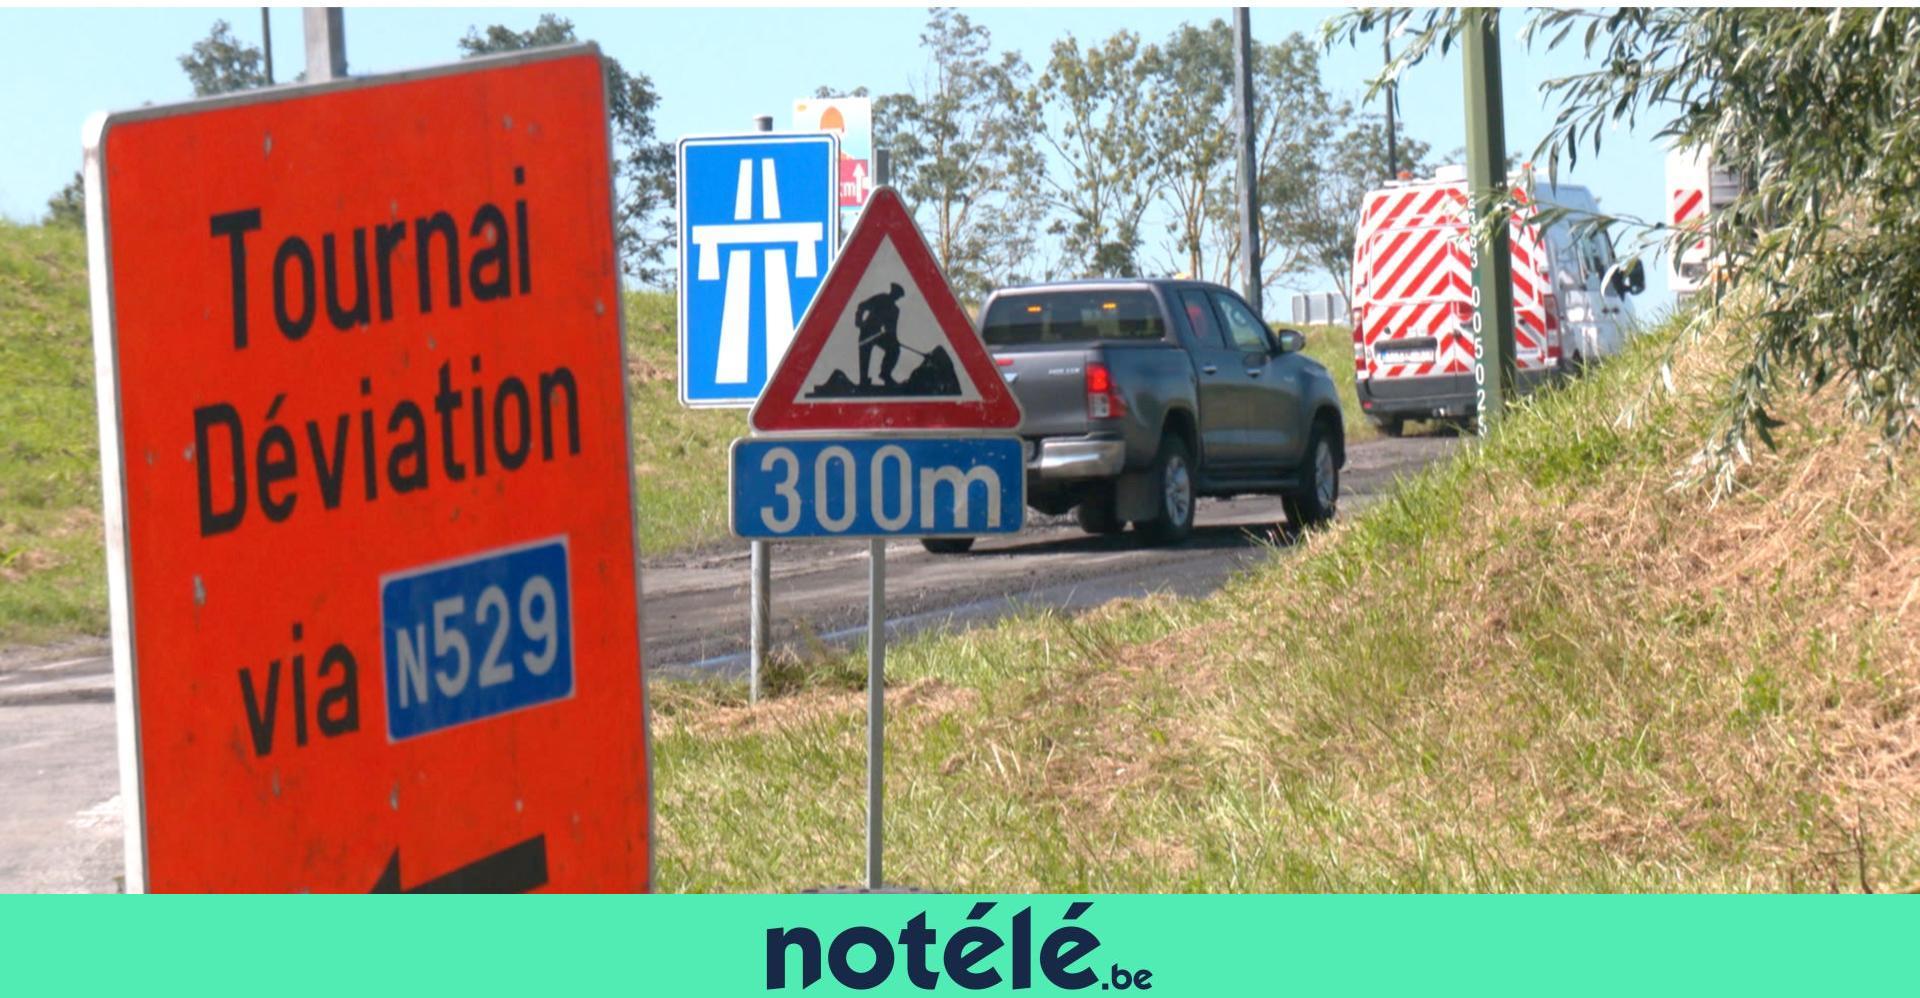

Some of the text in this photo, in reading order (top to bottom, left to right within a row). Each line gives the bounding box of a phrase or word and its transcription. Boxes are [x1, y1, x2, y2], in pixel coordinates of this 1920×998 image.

[210, 166, 532, 350] Tournai
[194, 355, 581, 538] Déviation
[760, 445, 1000, 533] 300m
[238, 575, 558, 757] via N529
